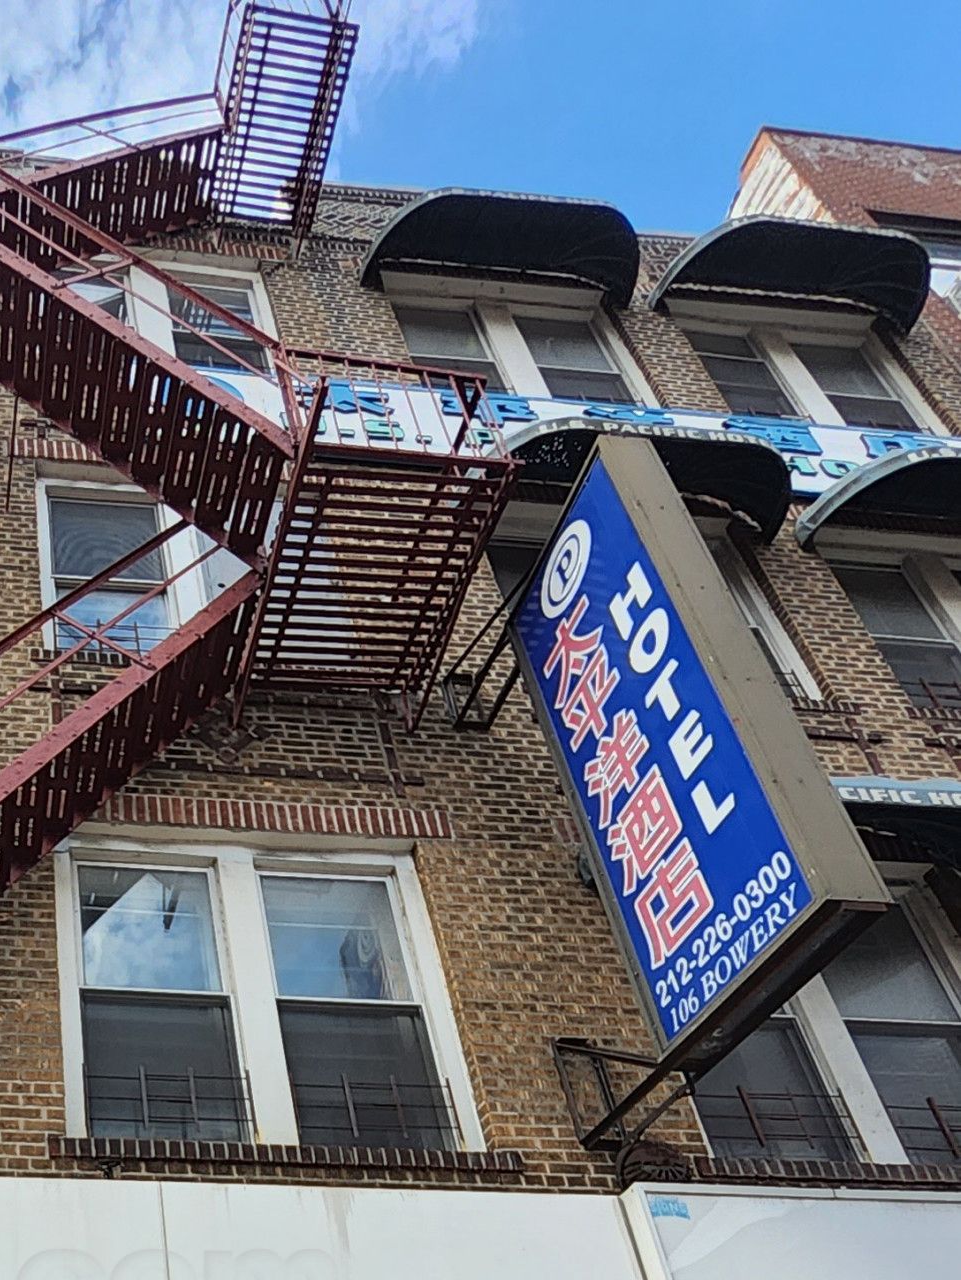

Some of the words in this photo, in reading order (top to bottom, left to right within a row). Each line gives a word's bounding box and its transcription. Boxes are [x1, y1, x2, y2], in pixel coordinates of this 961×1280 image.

[602, 421, 703, 441] PACIFIC
[609, 561, 736, 835] HOTEL
[543, 593, 714, 970] 太平洋酒店
[655, 850, 792, 1008] 212-226-0300
[669, 995, 699, 1033] 106
[699, 882, 799, 1002] BOWERY
